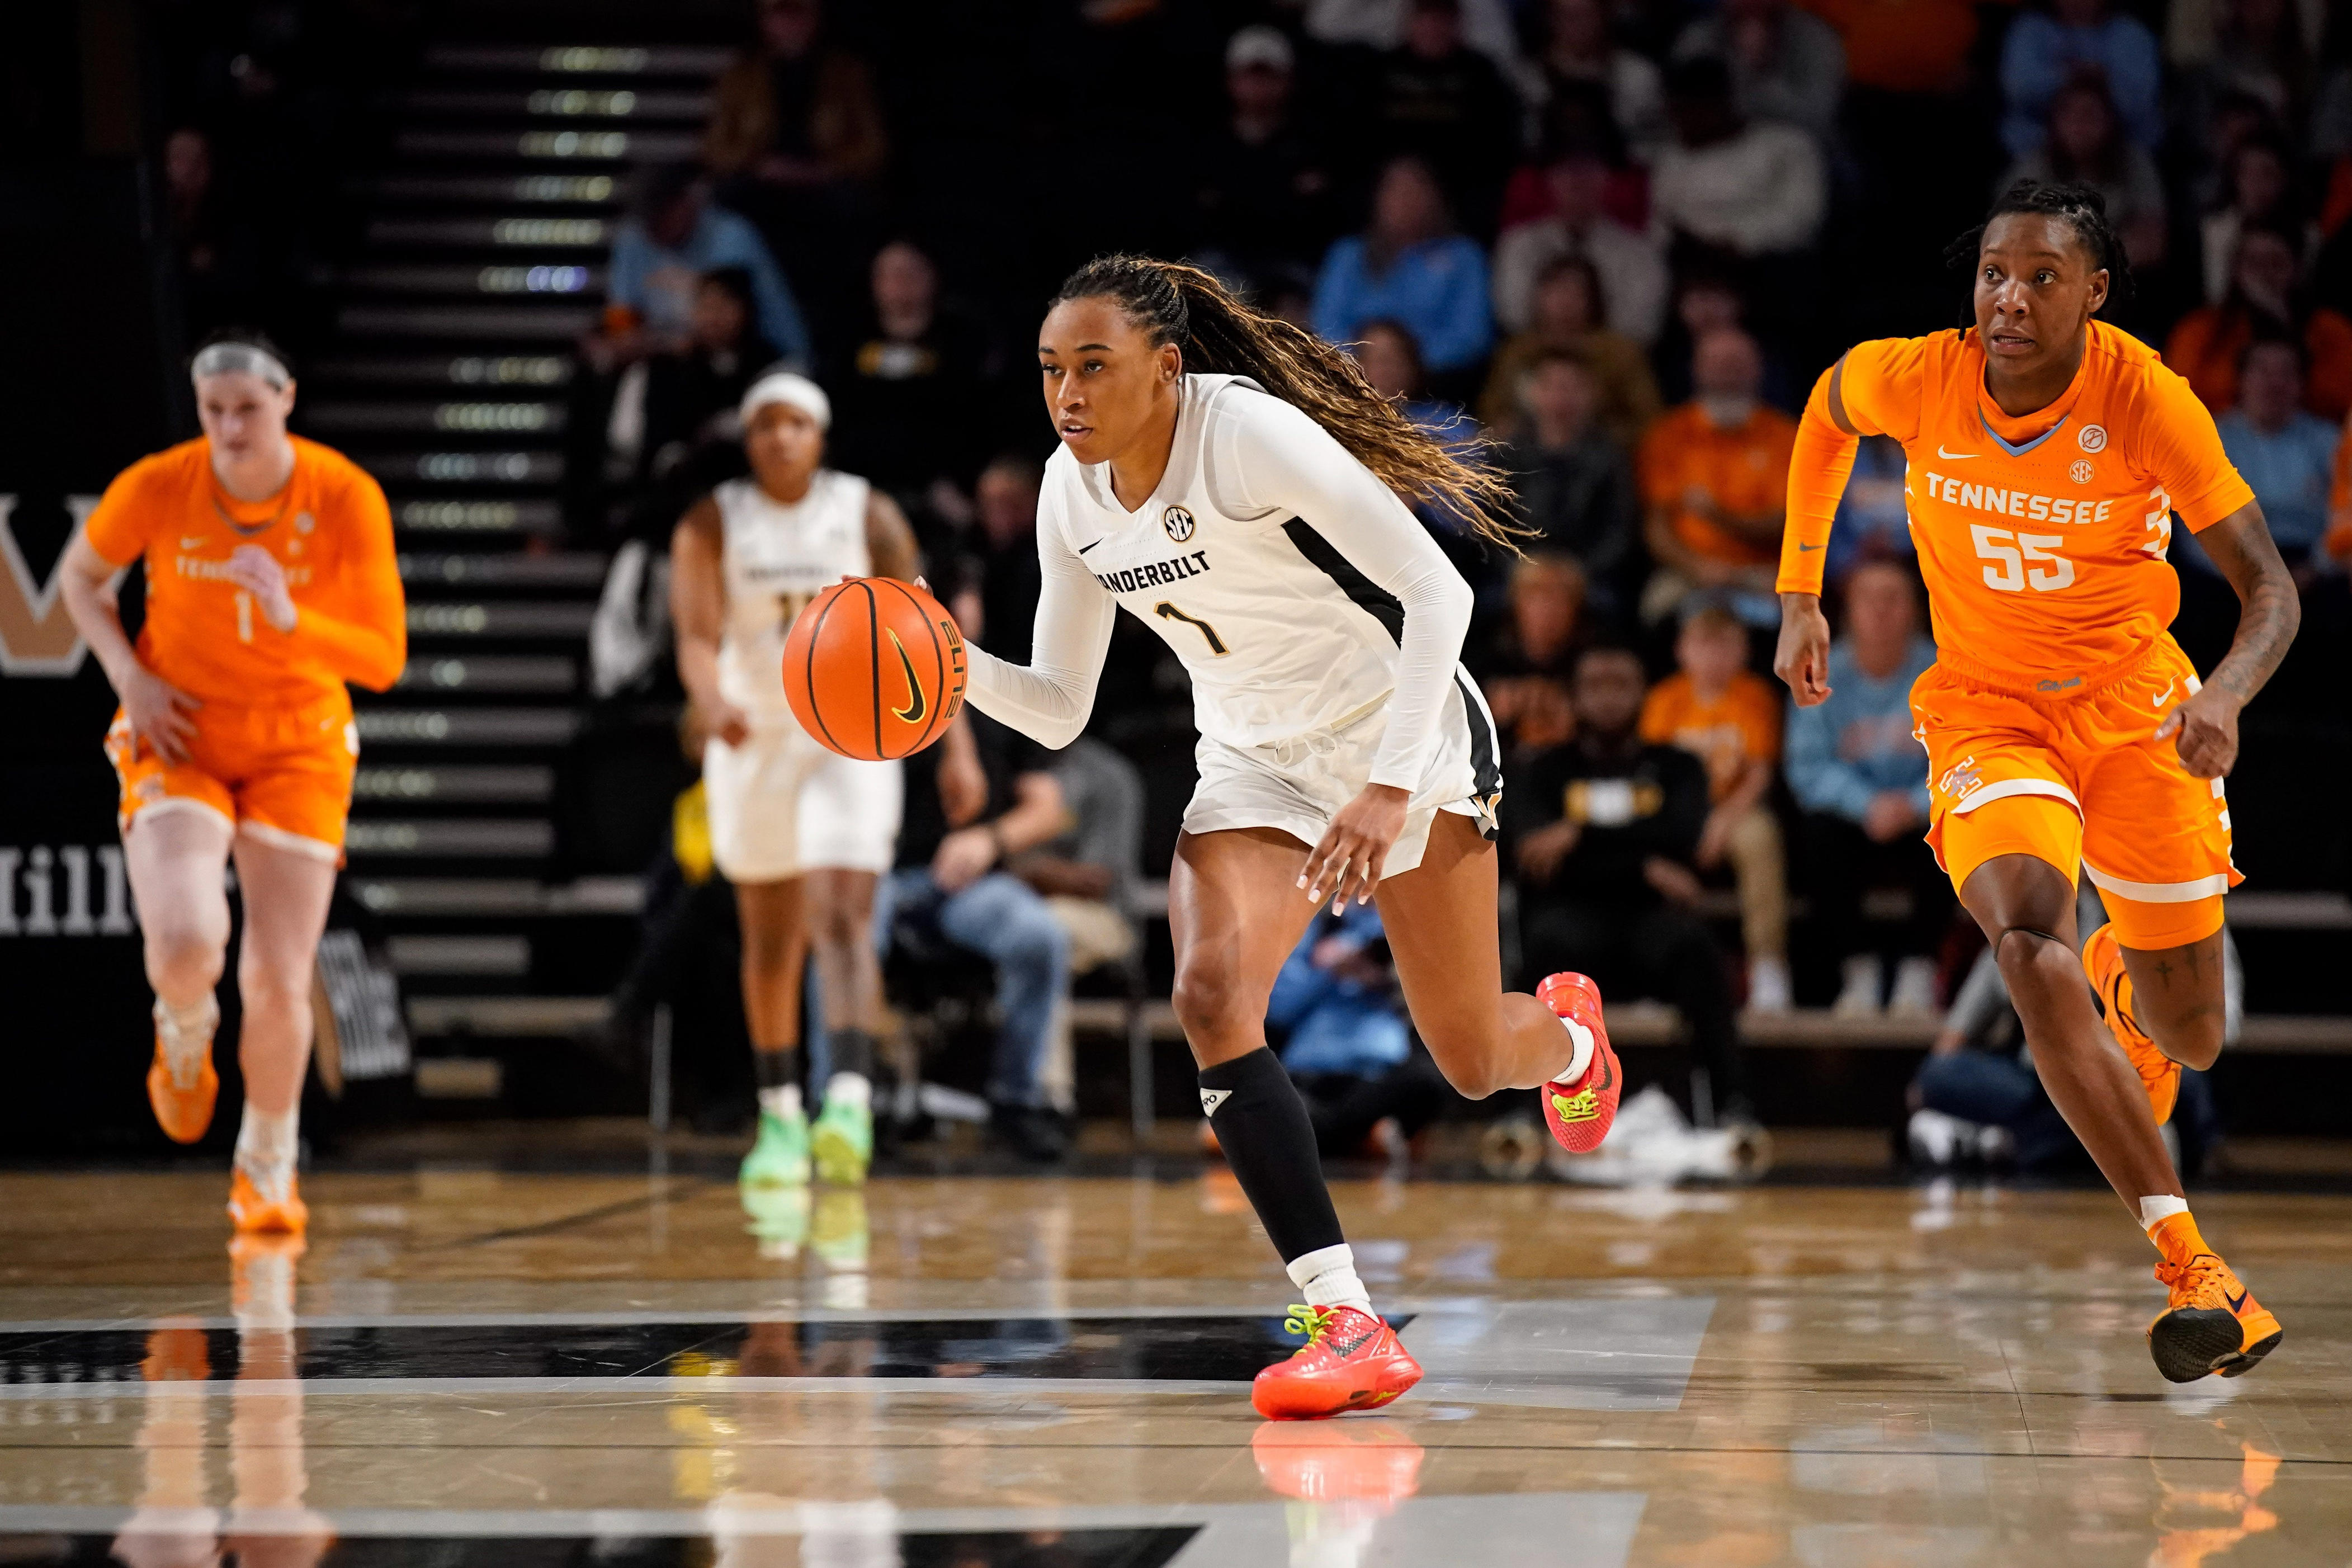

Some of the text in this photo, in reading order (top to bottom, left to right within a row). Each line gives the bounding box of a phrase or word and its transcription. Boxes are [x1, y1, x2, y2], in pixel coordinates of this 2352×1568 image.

[1925, 471, 2114, 525] TENNESSEE
[2070, 460, 2093, 483] SEC
[1164, 506, 1194, 542] SEC
[1094, 550, 1211, 593] ANDERBILT
[1969, 523, 2076, 592] 55
[233, 589, 253, 643] 1
[1153, 600, 1231, 657] 1
[939, 620, 965, 719] ELITE
